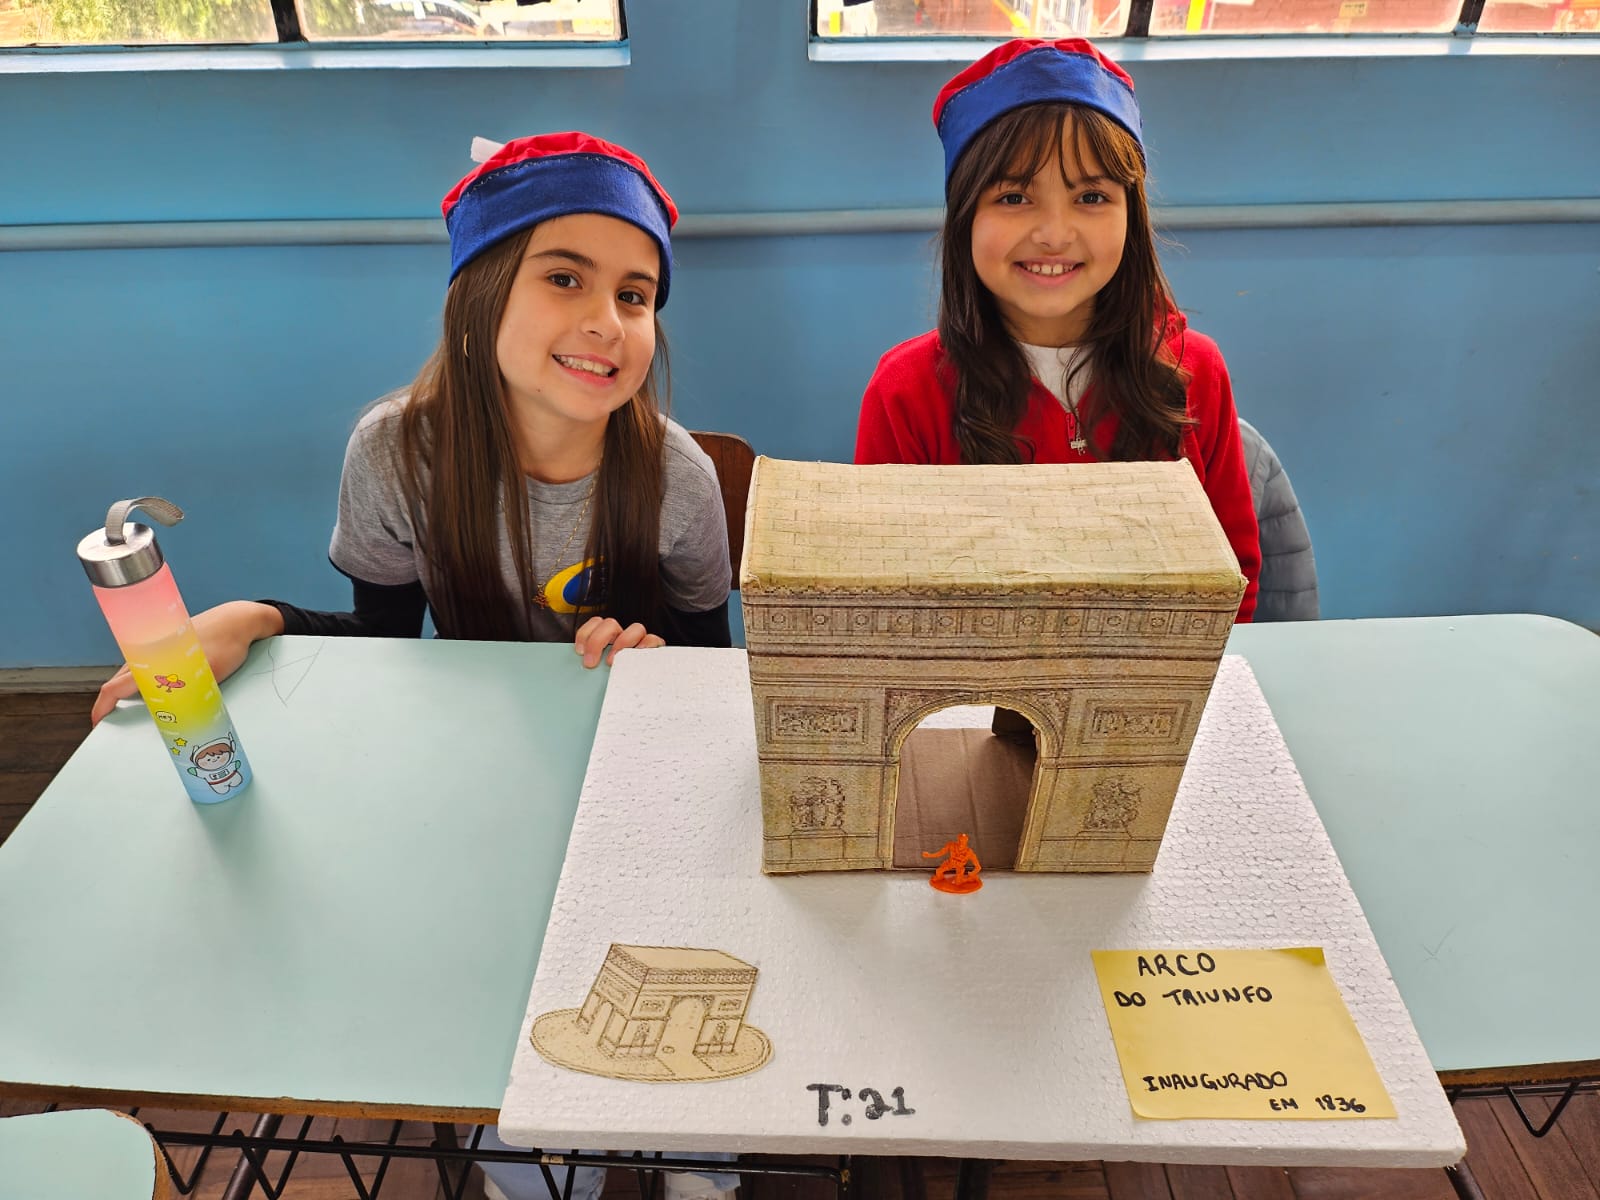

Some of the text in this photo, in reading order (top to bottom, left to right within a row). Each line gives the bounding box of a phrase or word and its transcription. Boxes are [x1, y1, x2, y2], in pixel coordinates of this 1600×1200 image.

[1137, 952, 1216, 977] ARCO
[1113, 985, 1273, 1008] DO TRIUNFO
[1142, 1070, 1288, 1092] INAUGURADO
[806, 1083, 916, 1127] T:21
[1268, 1094, 1366, 1113] EM 1836
